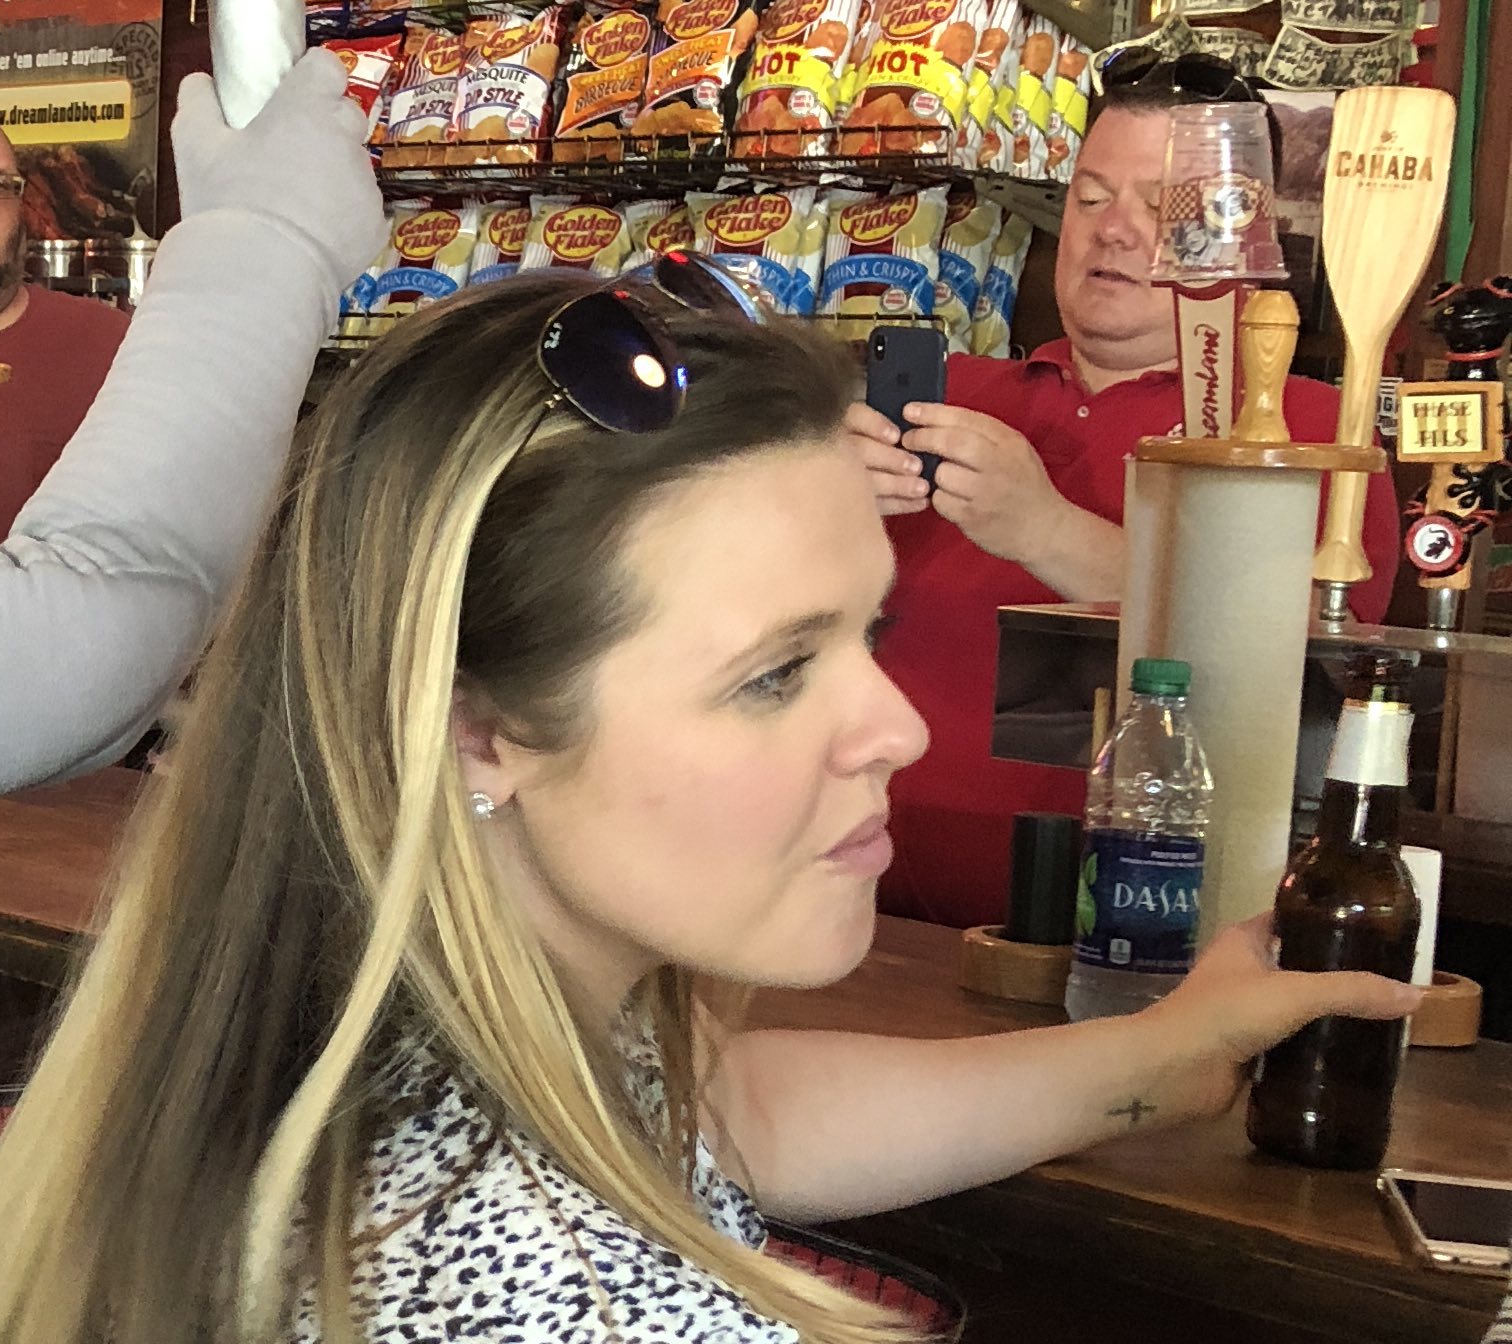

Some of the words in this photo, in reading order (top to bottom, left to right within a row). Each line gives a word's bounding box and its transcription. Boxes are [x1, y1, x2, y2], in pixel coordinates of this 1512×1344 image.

[36, 49, 68, 67] online
[751, 52, 801, 80] HOT
[870, 51, 928, 77] HOT
[465, 66, 530, 85] MESQUITE
[464, 89, 483, 109] DIP
[483, 86, 525, 106] STYLE
[1336, 150, 1433, 182] CAHABA
[707, 195, 789, 219] Golden
[397, 214, 459, 238] Golden
[548, 210, 619, 235] Golden
[718, 209, 781, 234] Flake
[850, 208, 910, 236] Flake
[402, 229, 452, 251] Flake
[553, 229, 613, 253] Flake
[872, 261, 919, 284] CRISPY
